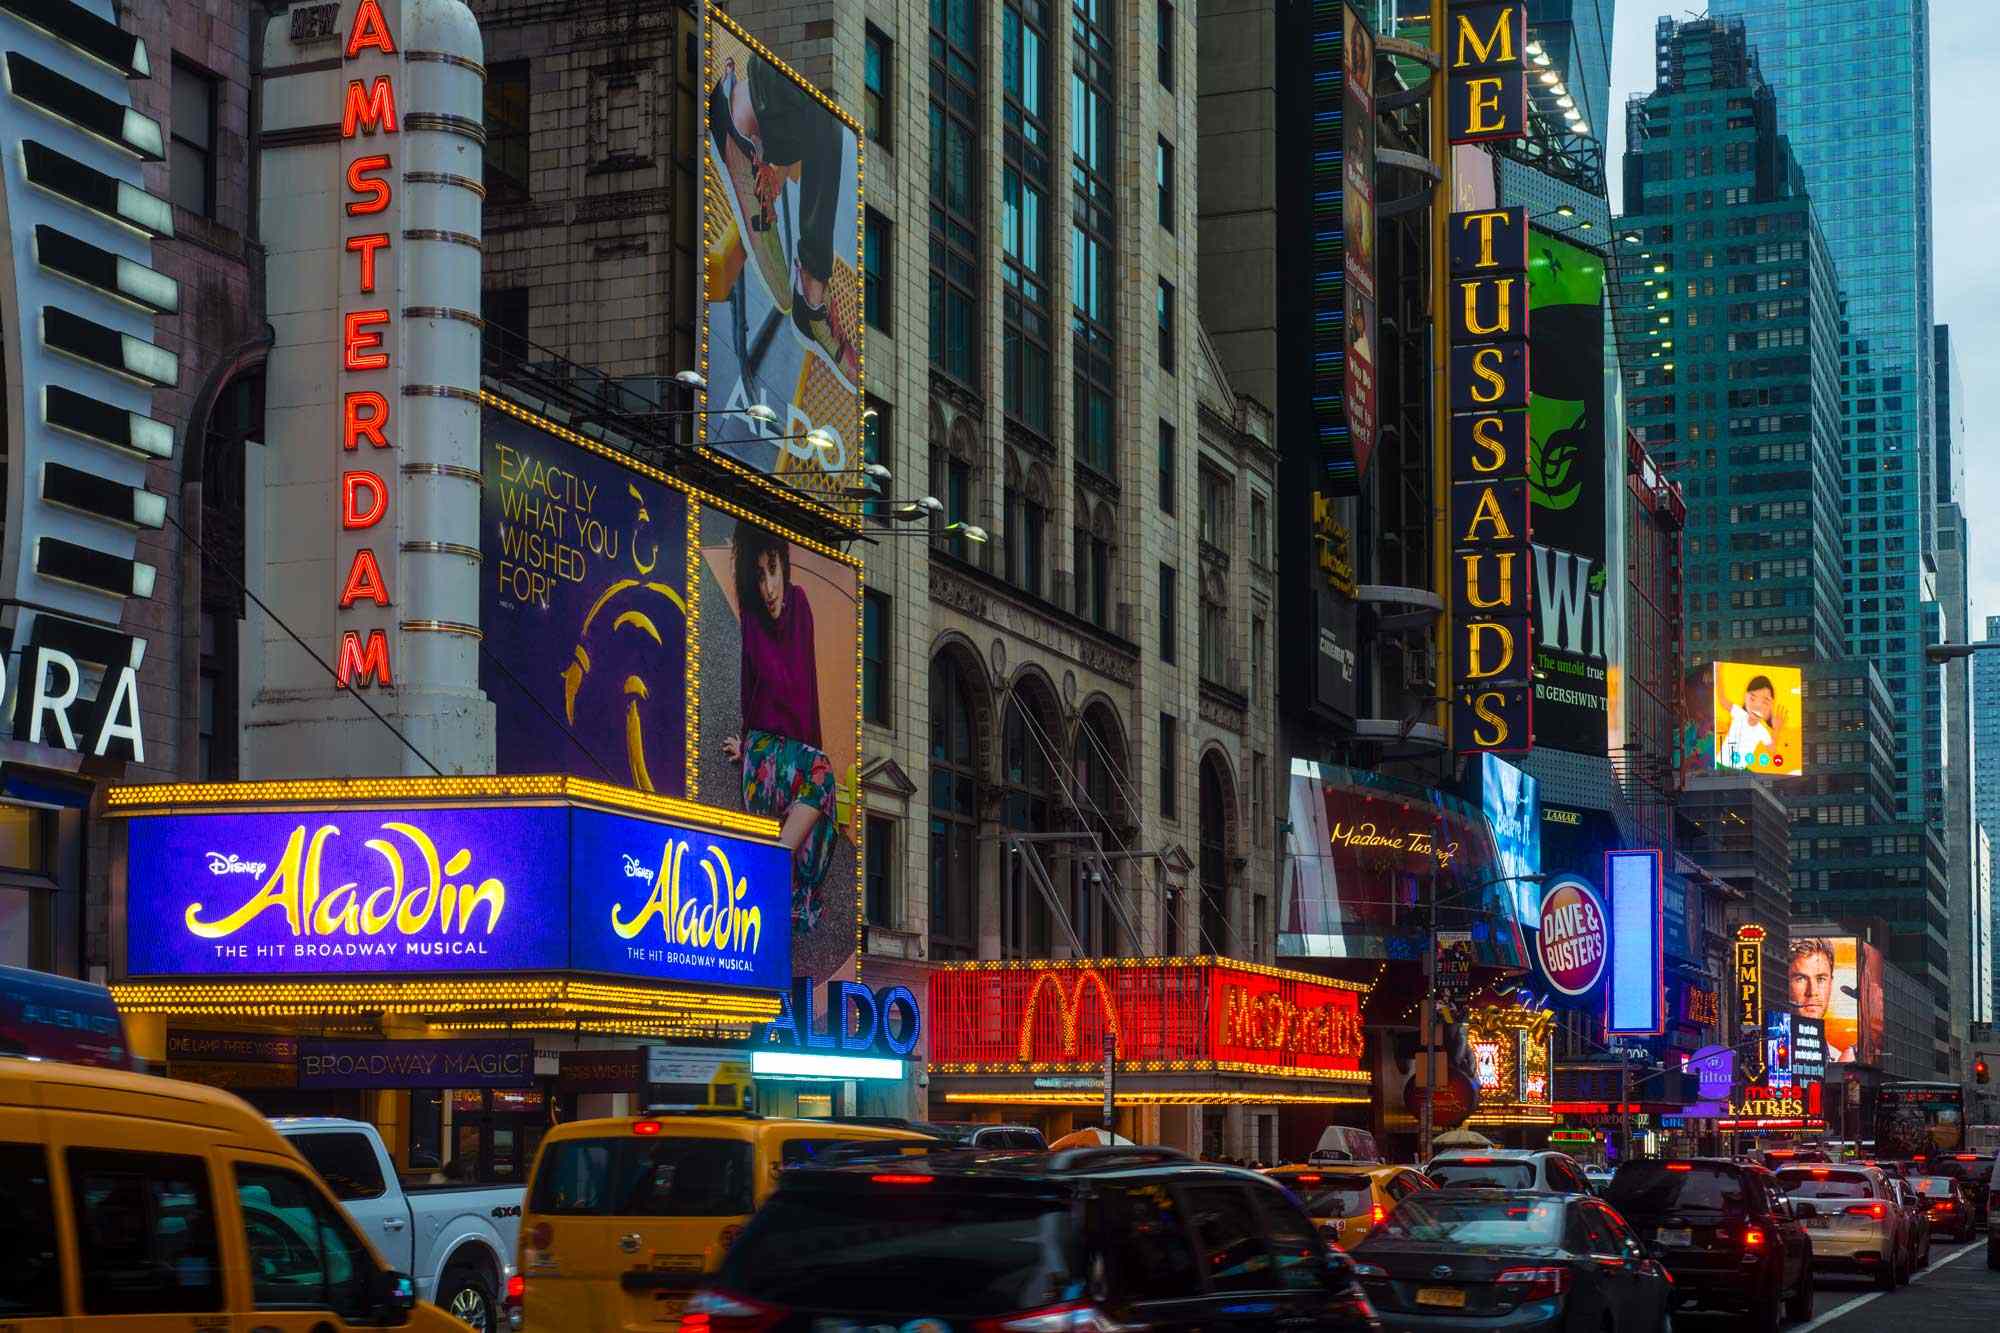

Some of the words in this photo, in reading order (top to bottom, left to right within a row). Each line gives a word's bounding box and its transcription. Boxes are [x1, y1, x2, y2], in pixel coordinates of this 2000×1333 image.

[337, 0, 398, 689] AMSTERDAM
[500, 482, 568, 539] WHAT
[575, 512, 619, 559] YOU
[500, 521, 587, 583] WISHED
[1538, 654, 1555, 671] The
[1557, 658, 1585, 677] untold
[1586, 665, 1605, 681] true
[0, 645, 145, 763] RA
[1546, 685, 1598, 710] GERSHWIN
[1331, 822, 1405, 849] Madame
[185, 822, 506, 938] Aladdin
[611, 838, 761, 955] Aladdin
[1543, 907, 1583, 942] DAVE
[1585, 903, 1599, 926] &
[216, 945, 248, 958] THE
[257, 944, 285, 957] HIT
[295, 943, 397, 957] BROADWAY
[406, 941, 487, 956] MUSICAL
[628, 947, 645, 960] THE
[648, 949, 664, 962] HIT
[667, 951, 716, 968] BROADWAY
[718, 957, 754, 972] MUSICAL
[1546, 938, 1602, 973] BUSTER'S
[765, 976, 922, 1056] ALDO
